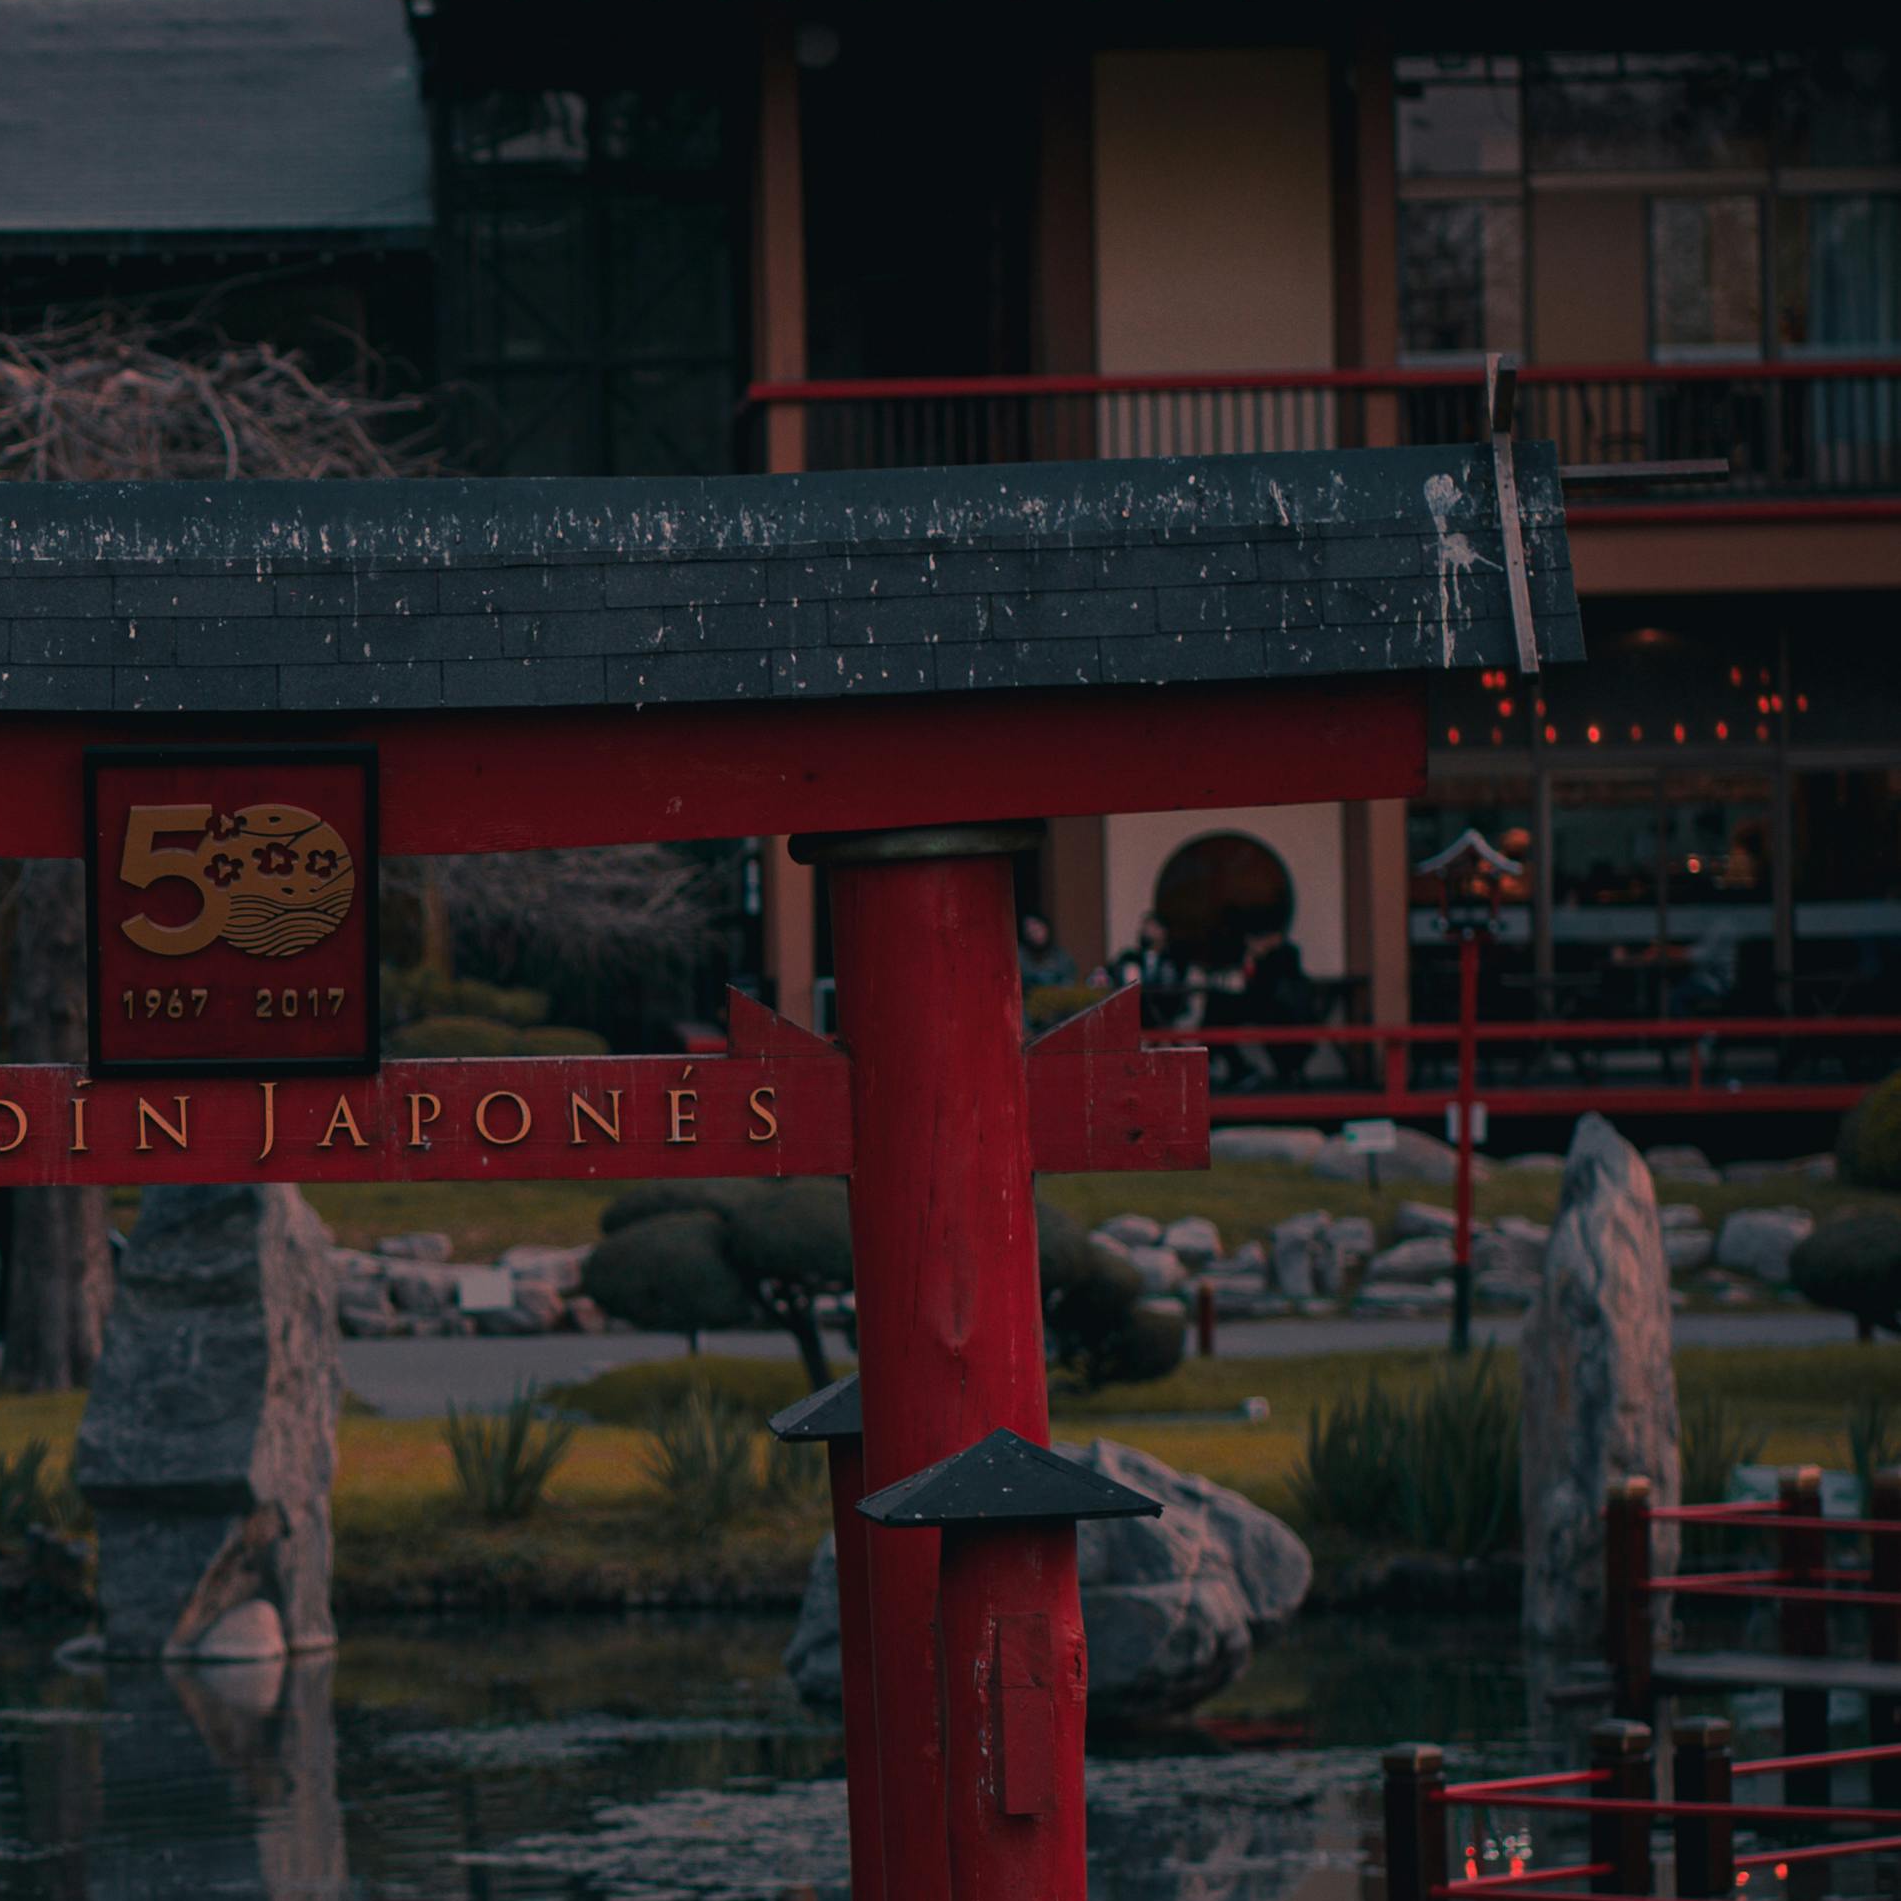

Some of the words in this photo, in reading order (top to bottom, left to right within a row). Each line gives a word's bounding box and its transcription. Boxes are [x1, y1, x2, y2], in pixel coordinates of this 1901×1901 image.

[119, 803, 355, 957] 50
[122, 987, 209, 1020] 1967
[254, 987, 345, 1019] 2017
[256, 1064, 779, 1162] JAPONÉS
